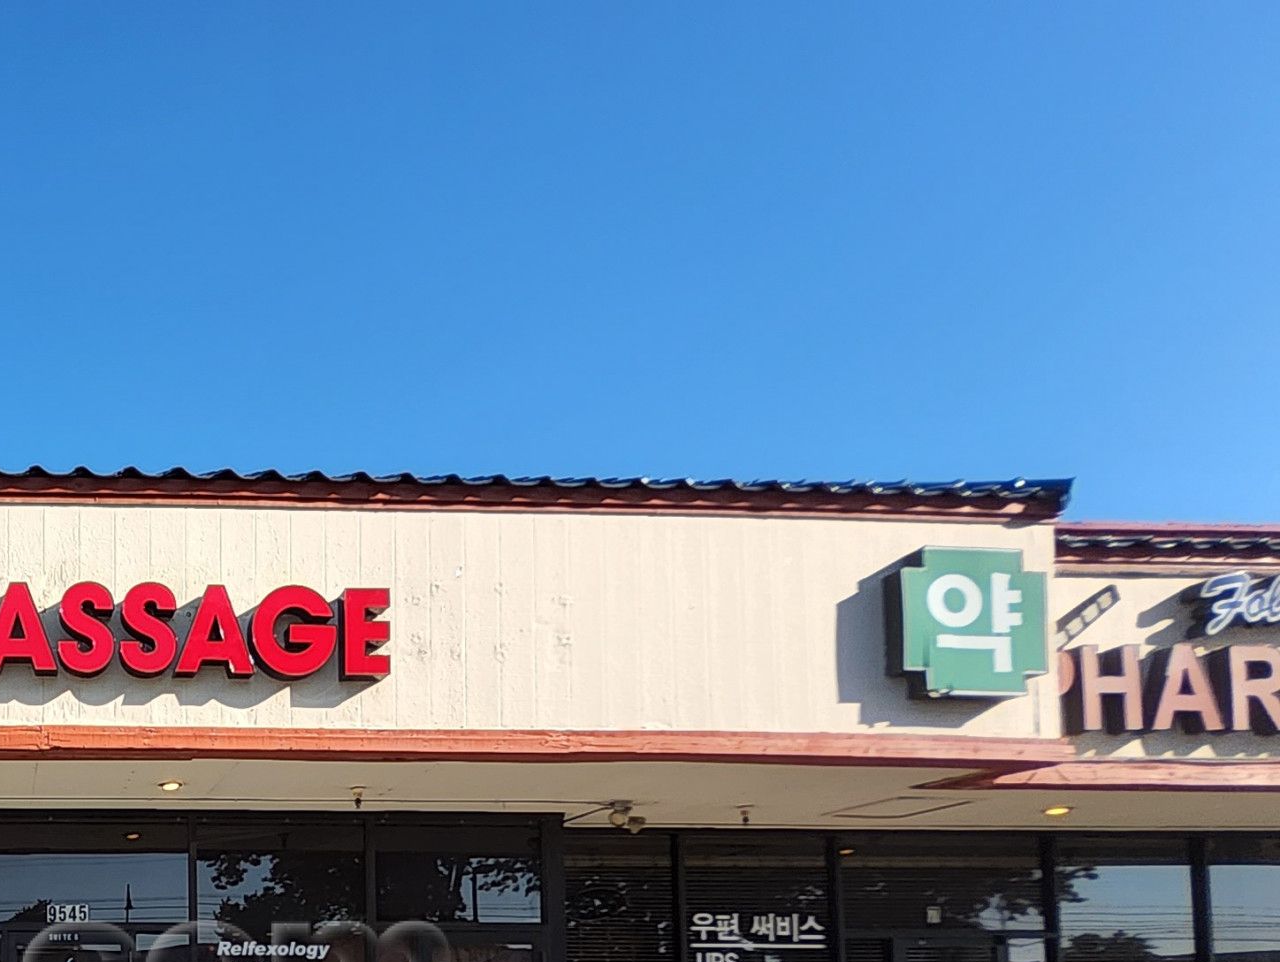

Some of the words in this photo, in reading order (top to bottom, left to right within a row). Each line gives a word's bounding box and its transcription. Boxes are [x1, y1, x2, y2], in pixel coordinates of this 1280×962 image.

[927, 573, 1023, 673] 약
[48, 904, 88, 922] 9545
[689, 912, 740, 942] 우편
[750, 912, 827, 943] 써비스
[217, 941, 330, 960] Relfexology
